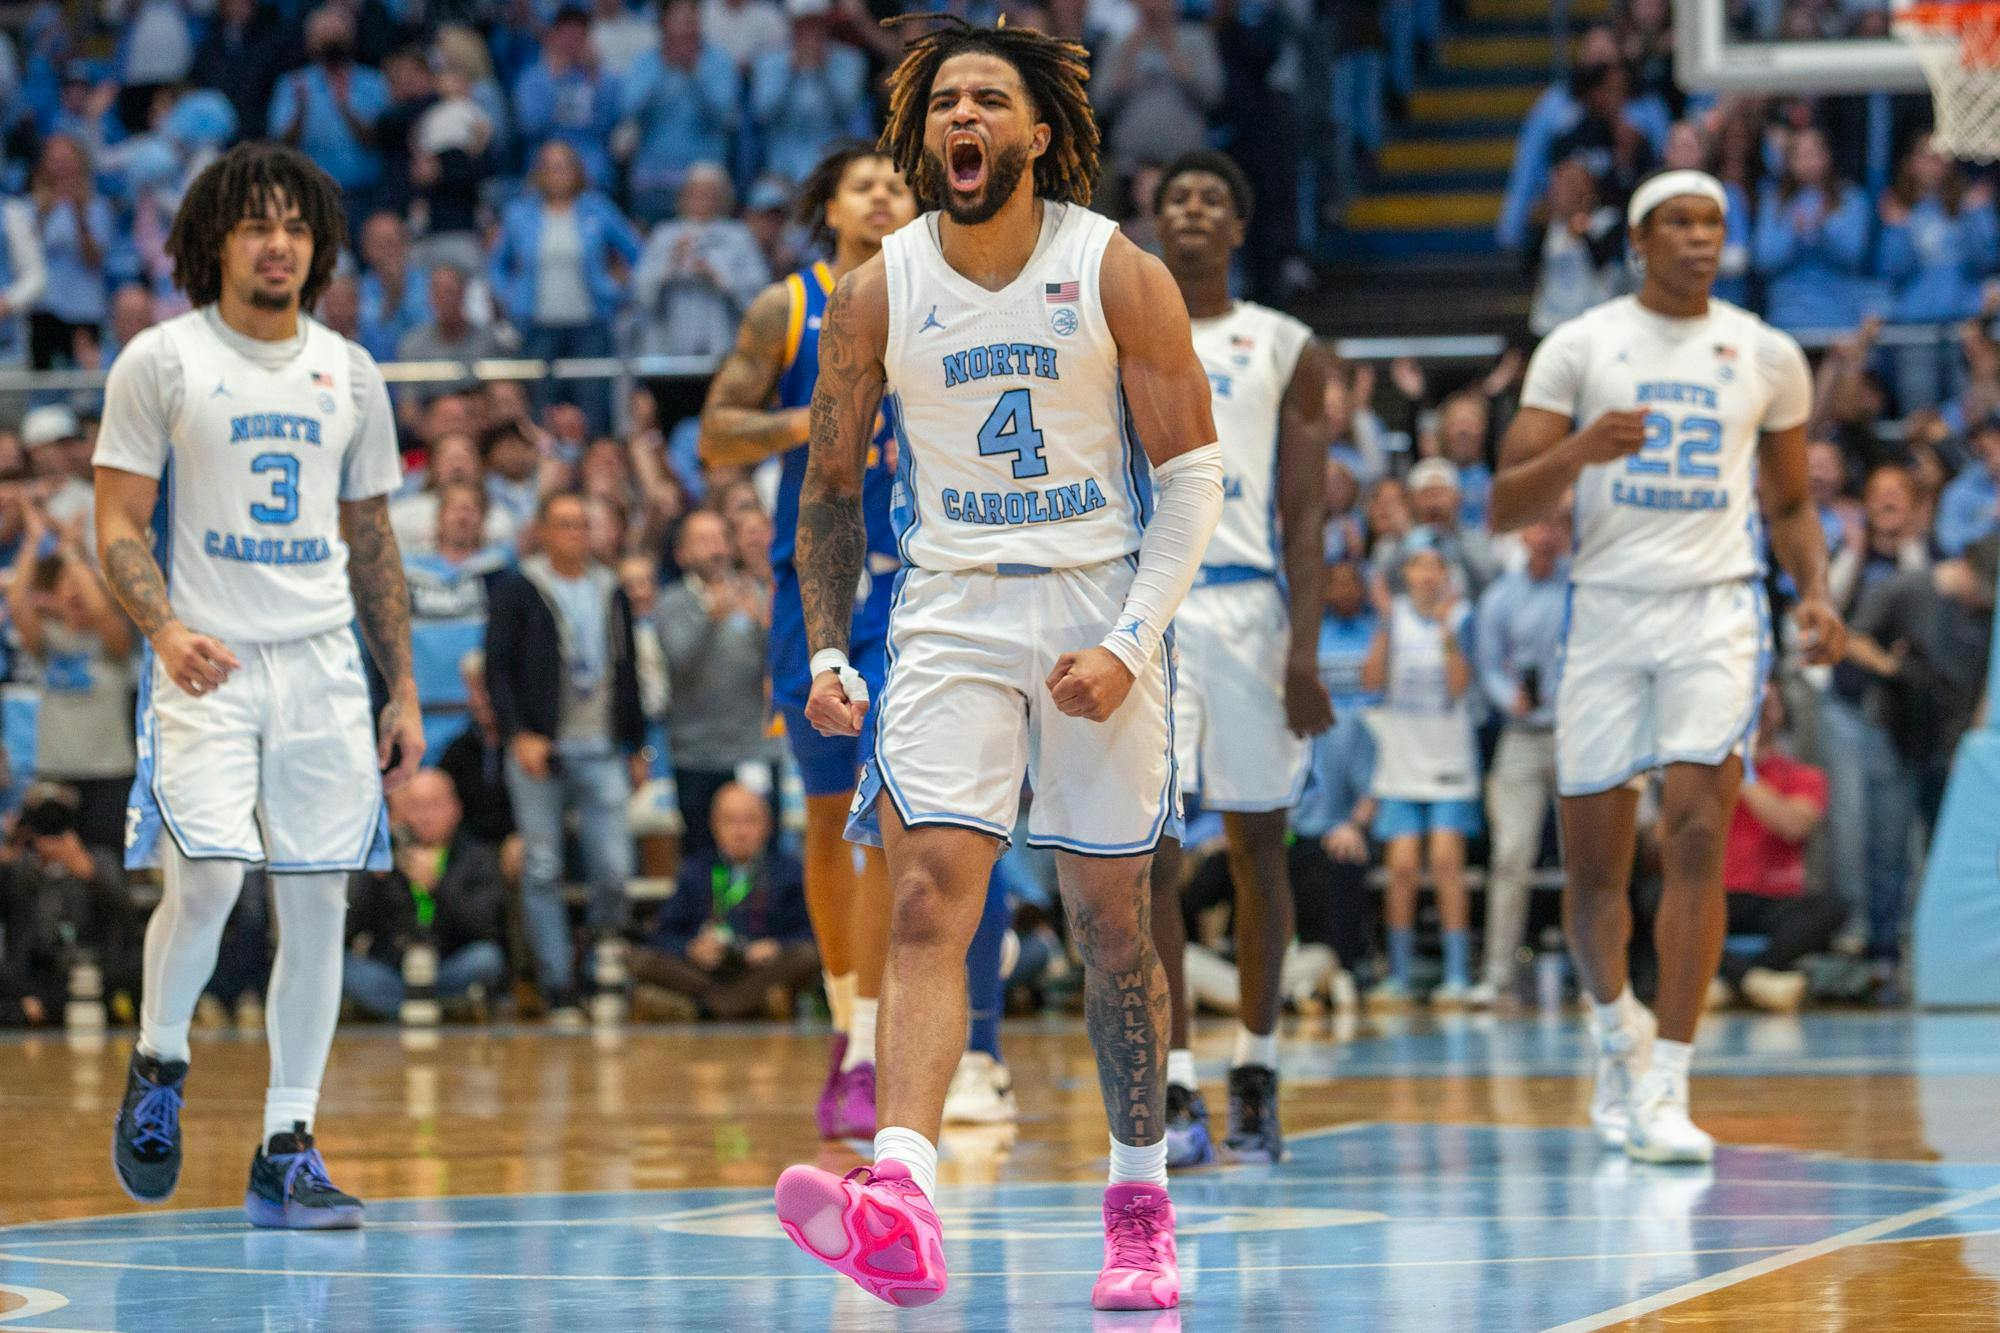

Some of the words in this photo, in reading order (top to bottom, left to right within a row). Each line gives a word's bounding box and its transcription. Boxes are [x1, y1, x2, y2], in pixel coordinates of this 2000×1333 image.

[943, 343, 1059, 388] NORTH
[1636, 381, 1718, 409] NORTH
[230, 412, 322, 446] NORTH
[977, 388, 1048, 479] 4
[1626, 412, 1722, 476] 22
[250, 453, 300, 525] 3
[941, 477, 1107, 525] CAROLINA
[1612, 479, 1729, 512] CAROLINA
[203, 529, 332, 565] CAROLINA
